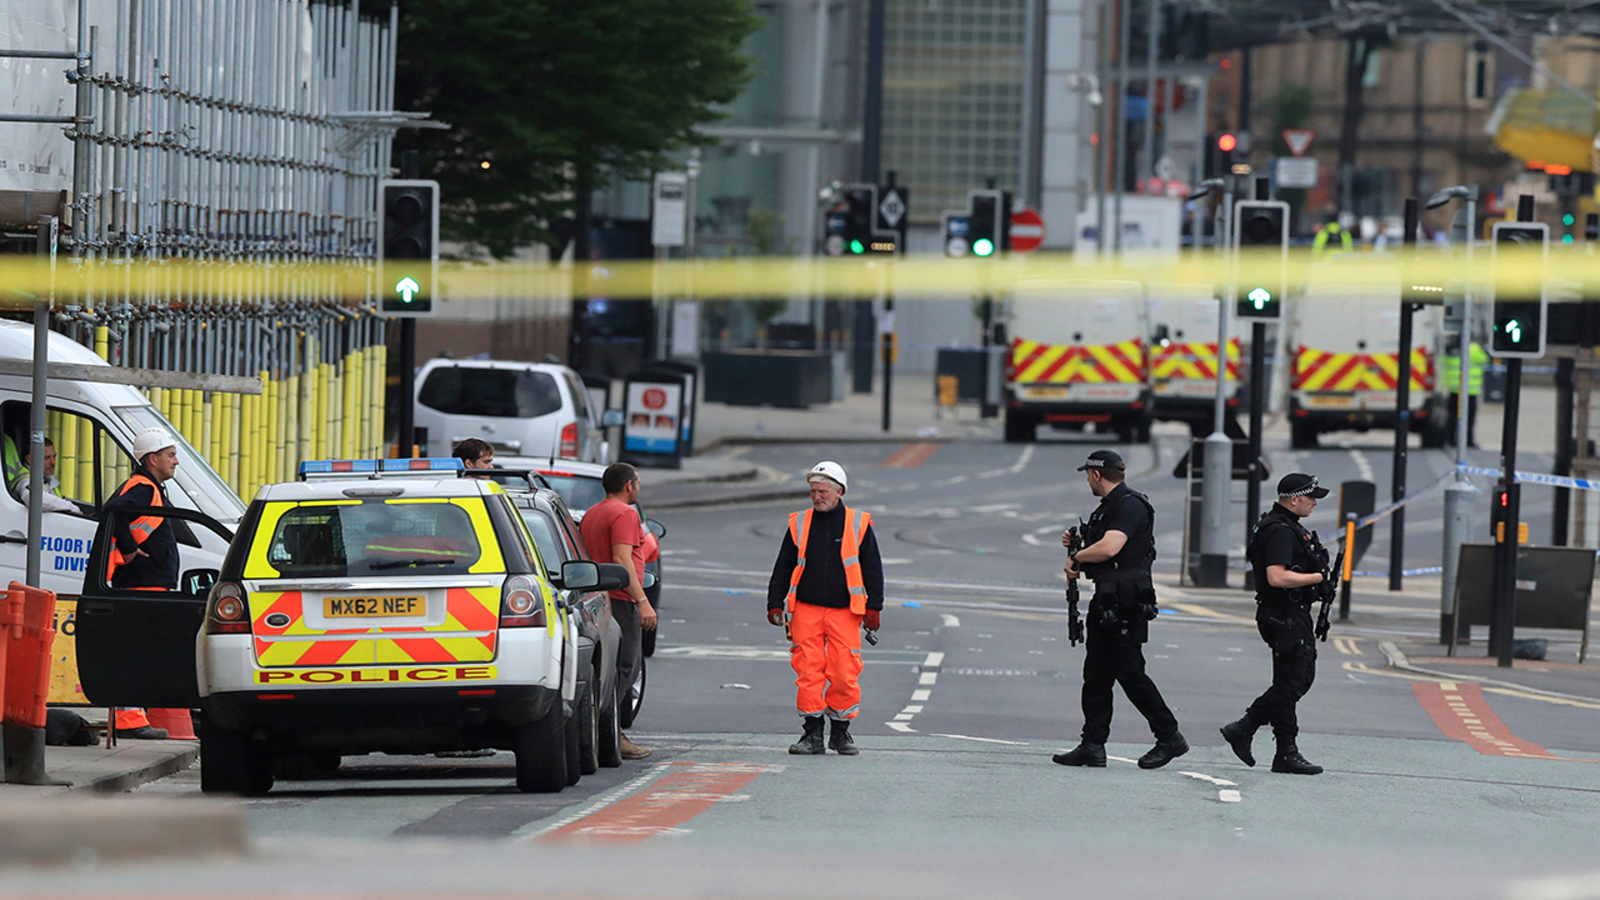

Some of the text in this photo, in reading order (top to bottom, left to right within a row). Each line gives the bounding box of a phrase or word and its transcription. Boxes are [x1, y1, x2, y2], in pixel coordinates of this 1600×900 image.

[40, 536, 83, 553] FLOOR
[331, 597, 418, 615] MX62 NEF
[259, 667, 491, 683] POLICE
